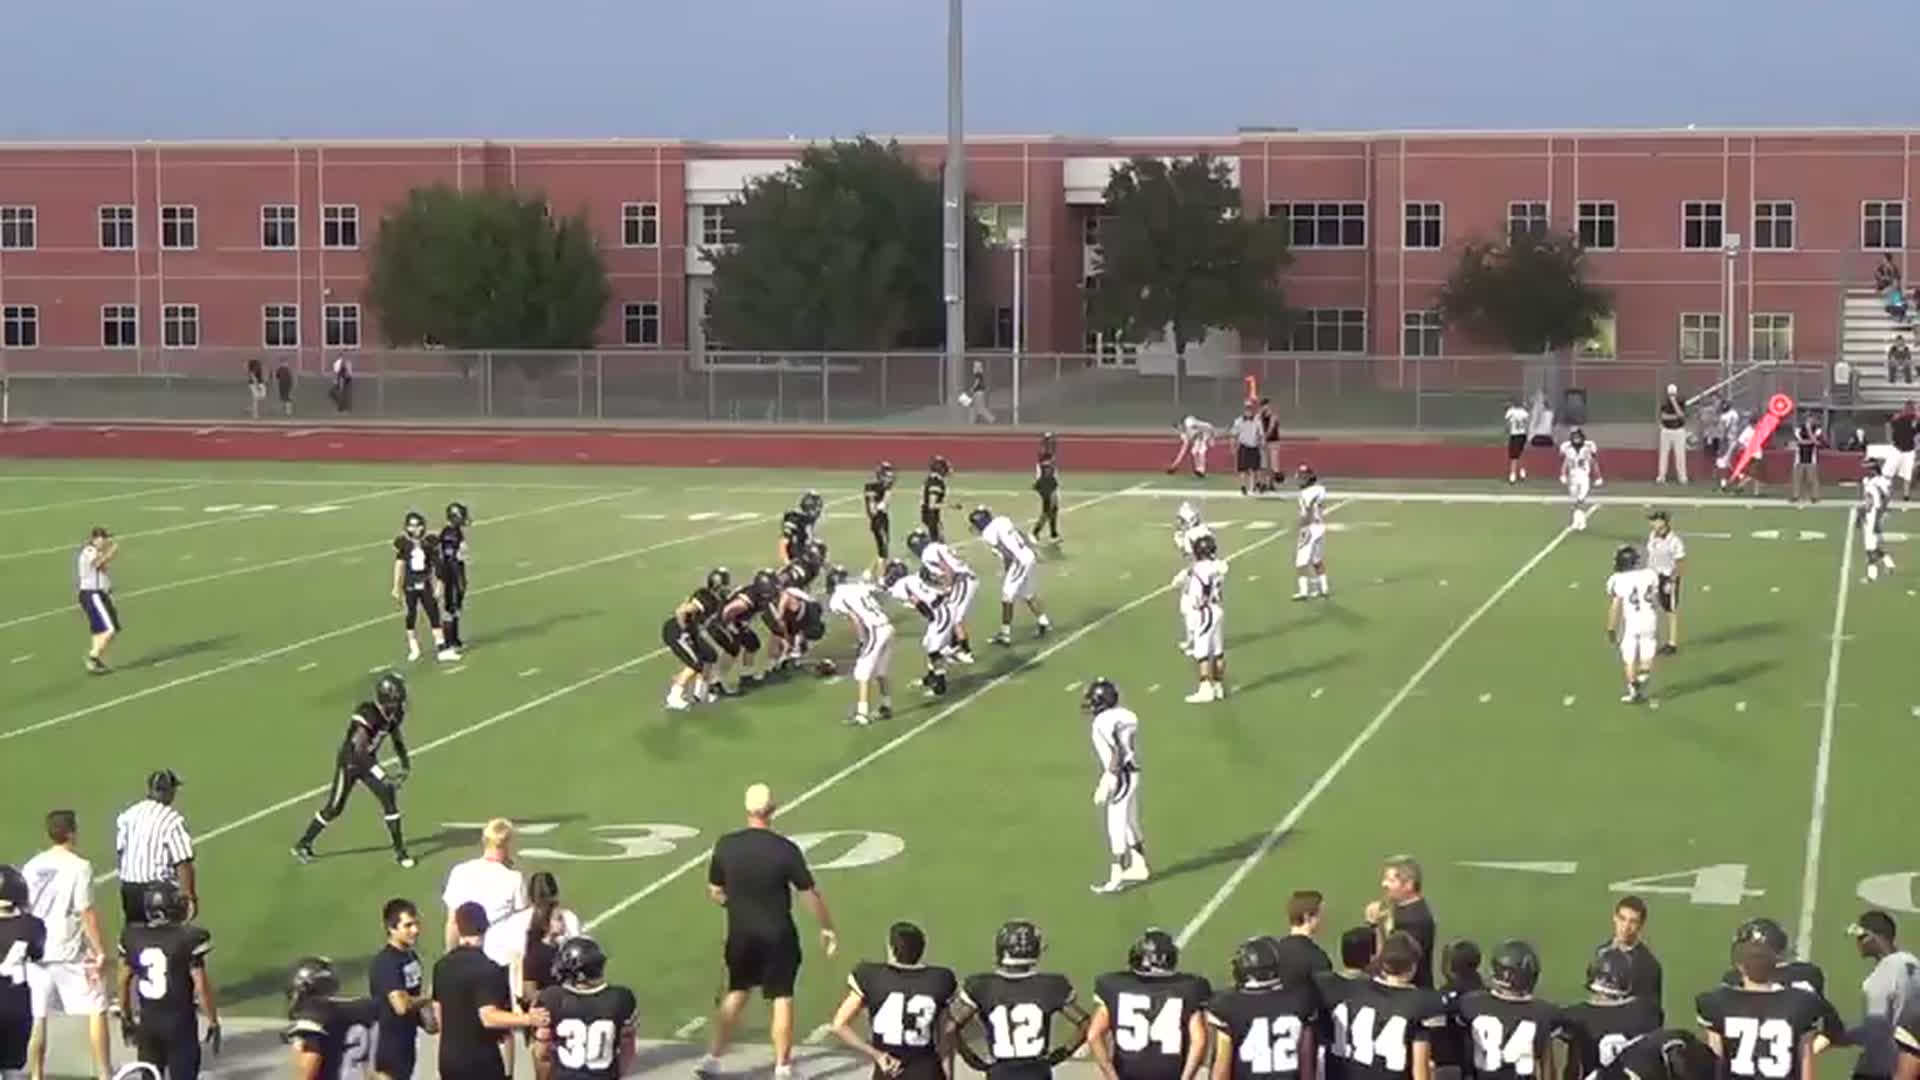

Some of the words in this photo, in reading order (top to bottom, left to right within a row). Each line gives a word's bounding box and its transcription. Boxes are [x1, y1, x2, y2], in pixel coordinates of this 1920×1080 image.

[138, 947, 168, 999] 3
[556, 1018, 616, 1069] 30
[872, 991, 937, 1046] 43
[988, 1002, 1046, 1059] 12
[1116, 992, 1184, 1055] 54
[1239, 1015, 1302, 1073] 42
[1471, 1014, 1538, 1075] 84
[1723, 1016, 1793, 1078] 73
